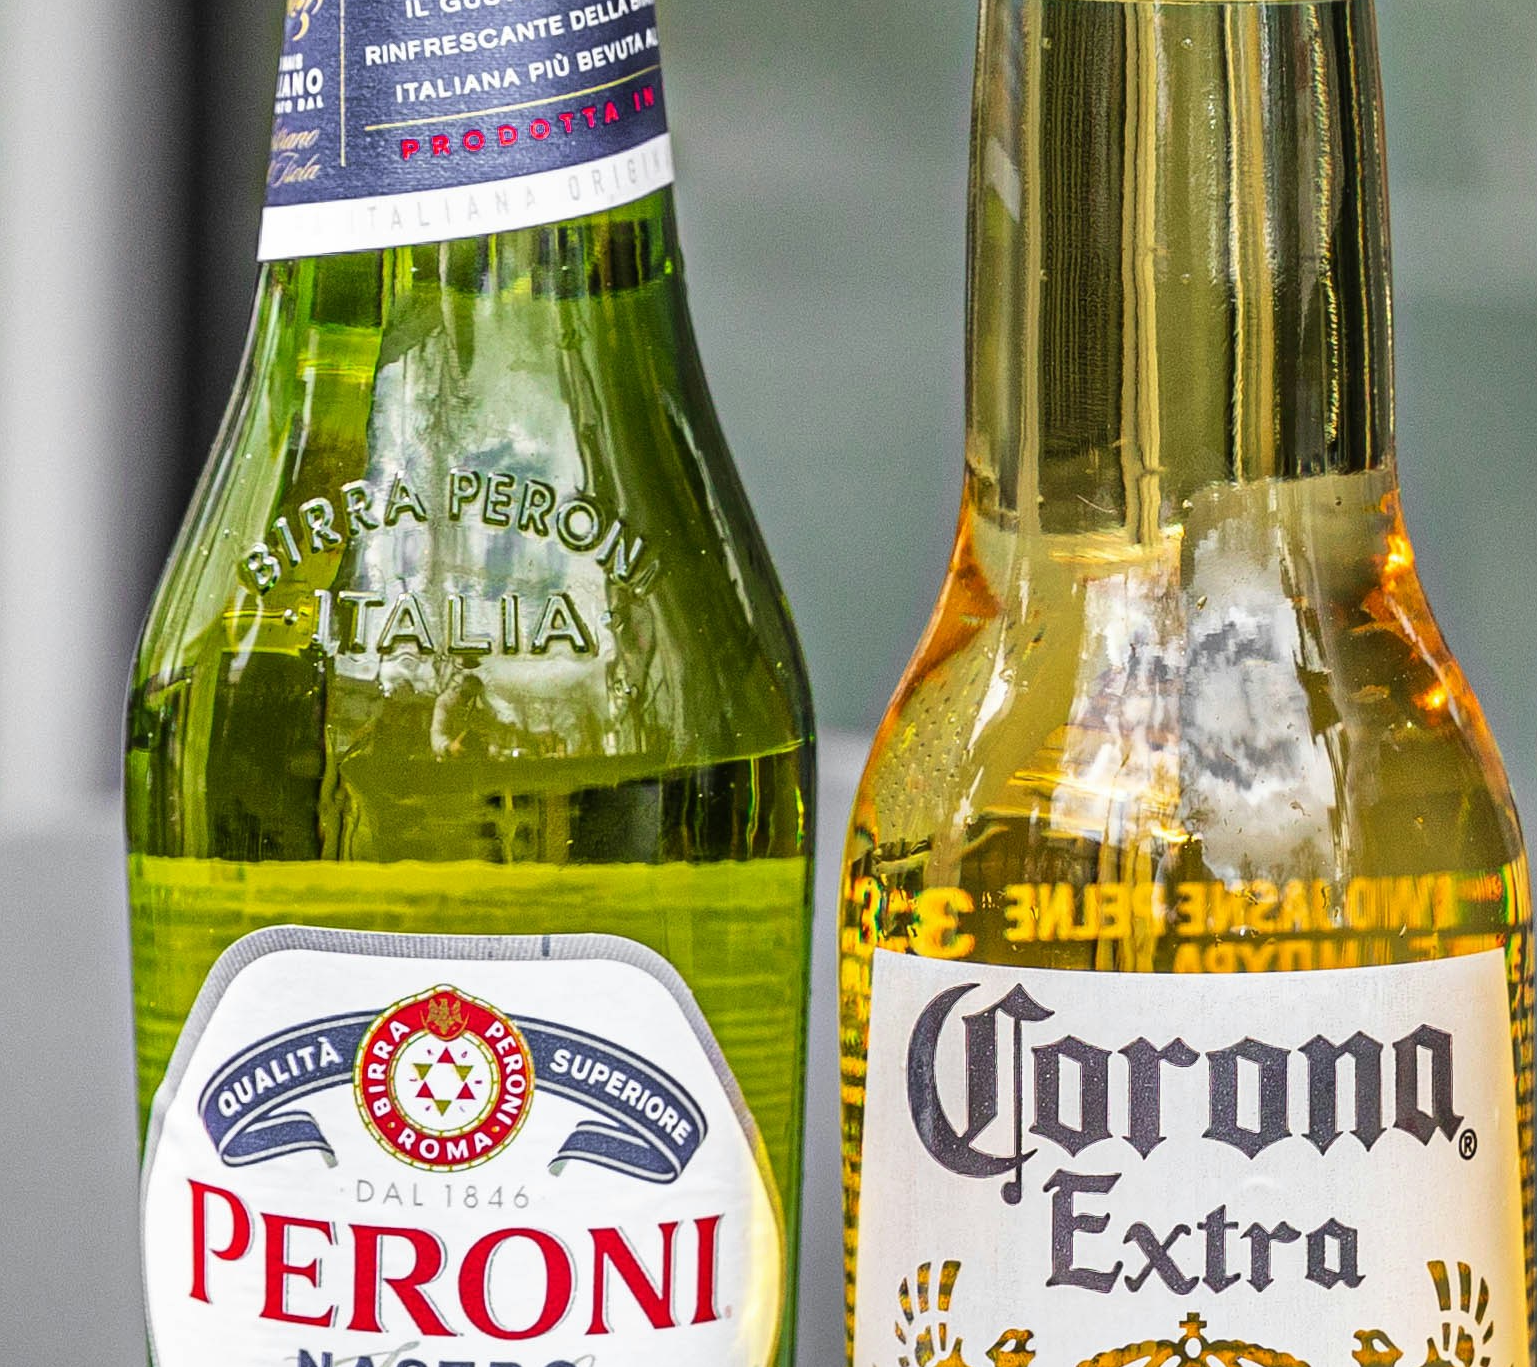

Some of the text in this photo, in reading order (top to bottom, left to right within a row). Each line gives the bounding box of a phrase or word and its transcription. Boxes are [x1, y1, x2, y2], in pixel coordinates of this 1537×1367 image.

[365, 18, 564, 67] RINFRESCANTE
[396, 67, 519, 103] ITALIANA
[530, 50, 570, 83] PIÙ
[578, 33, 644, 72] BEVUTA
[402, 86, 655, 160] PRODOTTA IN
[239, 469, 429, 595] BIRRA
[311, 590, 600, 656] ITALIA
[217, 1035, 344, 1119] QUALITÀ
[367, 1020, 412, 1118] BIRRA
[484, 1020, 527, 1126] PERONI
[549, 1046, 693, 1146] SUPERIORE
[906, 981, 1465, 1206] Corona
[397, 1127, 493, 1161] ROMA
[356, 1179, 530, 1209] DAL 1846
[1043, 1168, 1367, 1295] Extra
[187, 1178, 726, 1343] PERONI
